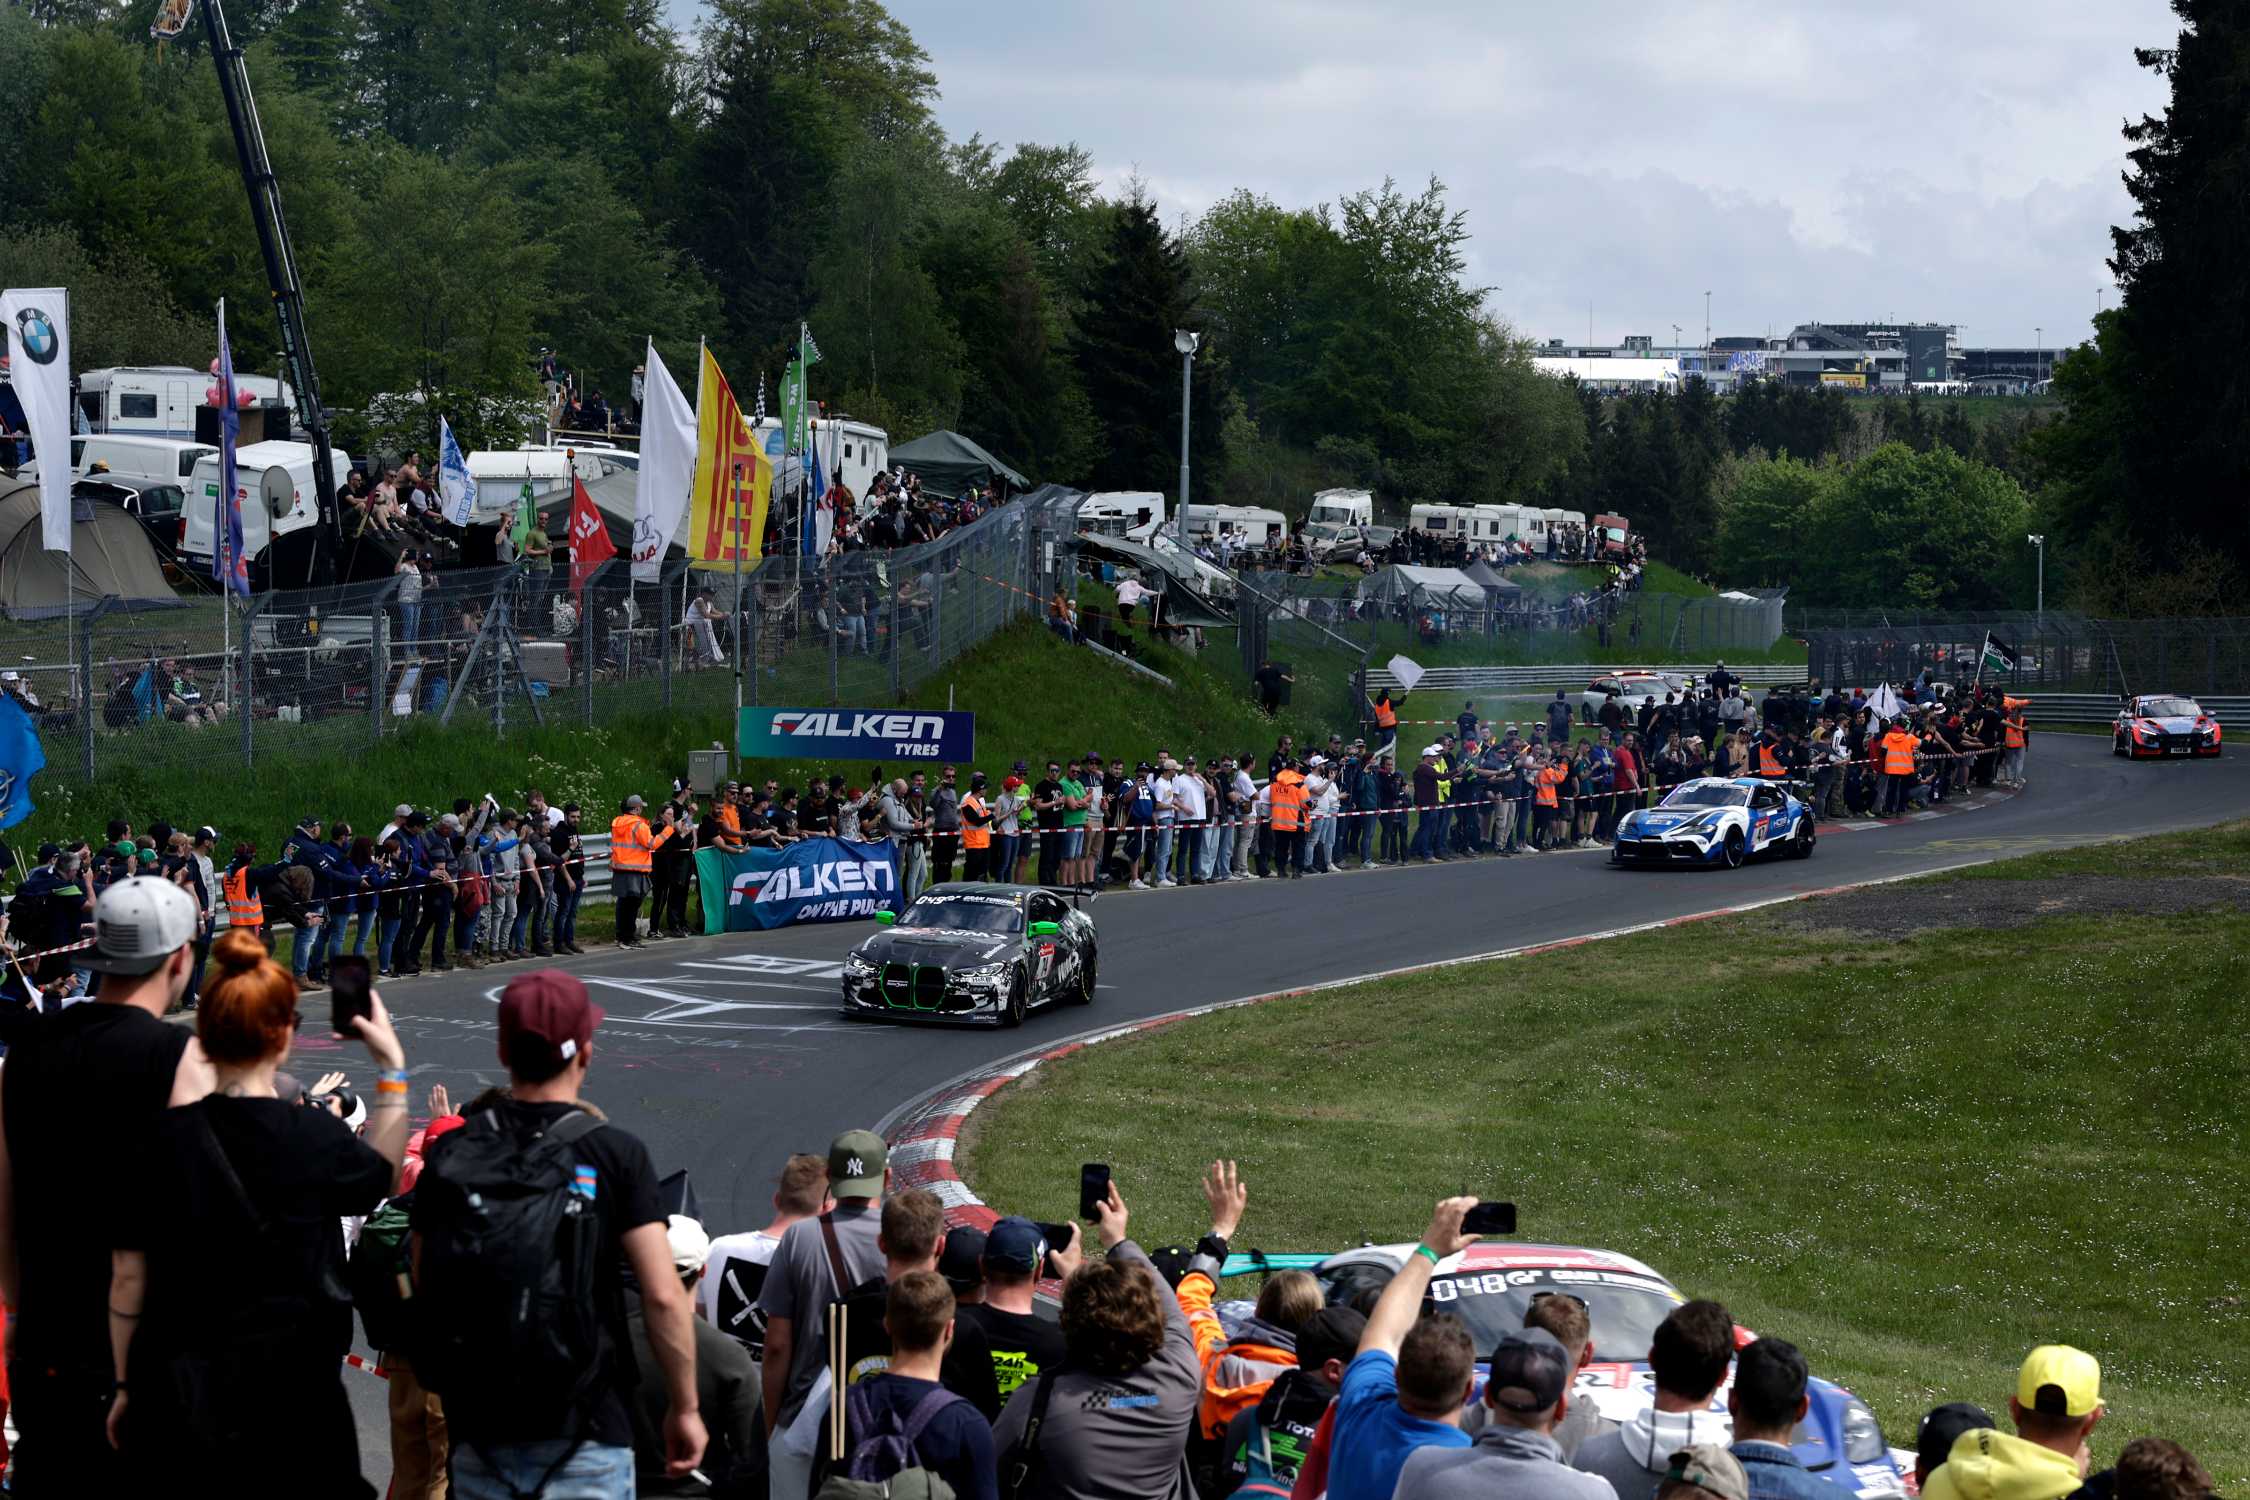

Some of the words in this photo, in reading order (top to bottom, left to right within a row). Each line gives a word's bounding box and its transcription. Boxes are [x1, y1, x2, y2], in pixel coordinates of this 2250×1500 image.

[771, 712, 944, 739] FALKEN
[895, 743, 939, 756] TYRES
[729, 861, 894, 905] FALKEN
[797, 904, 823, 919] ON
[822, 900, 847, 917] THE
[1432, 1273, 1507, 1302] 048
[994, 1356, 1024, 1369] 24h
